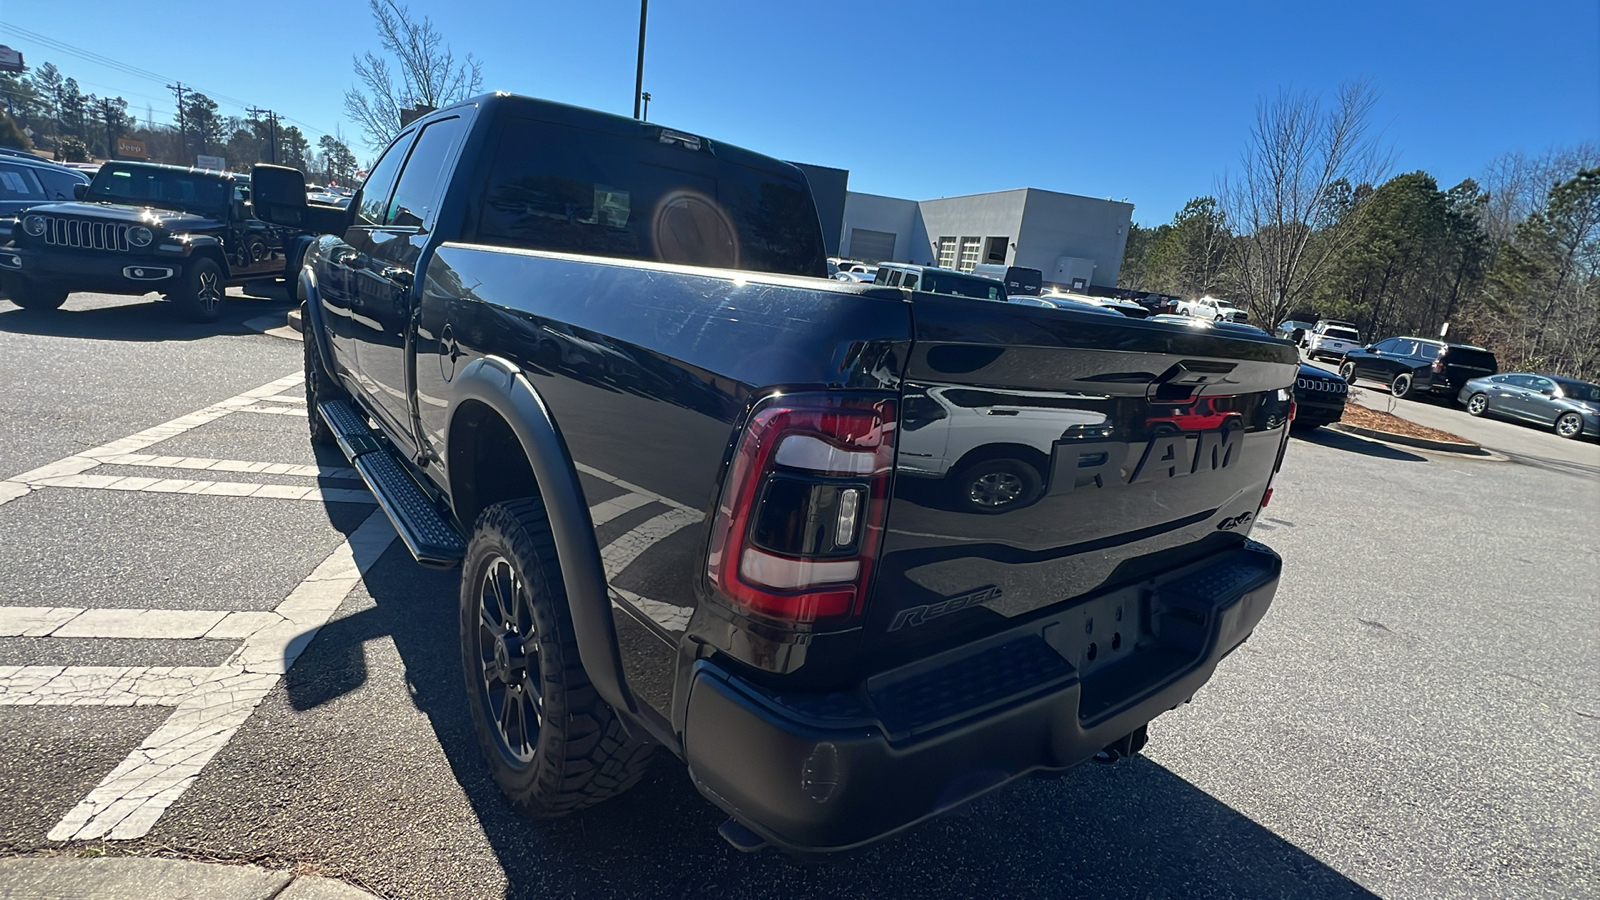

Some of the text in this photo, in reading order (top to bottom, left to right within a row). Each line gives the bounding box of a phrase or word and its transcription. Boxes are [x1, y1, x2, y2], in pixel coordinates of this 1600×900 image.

[119, 143, 141, 153] Jeep
[1048, 428, 1244, 496] RAM
[887, 585, 1002, 632] REBEL
